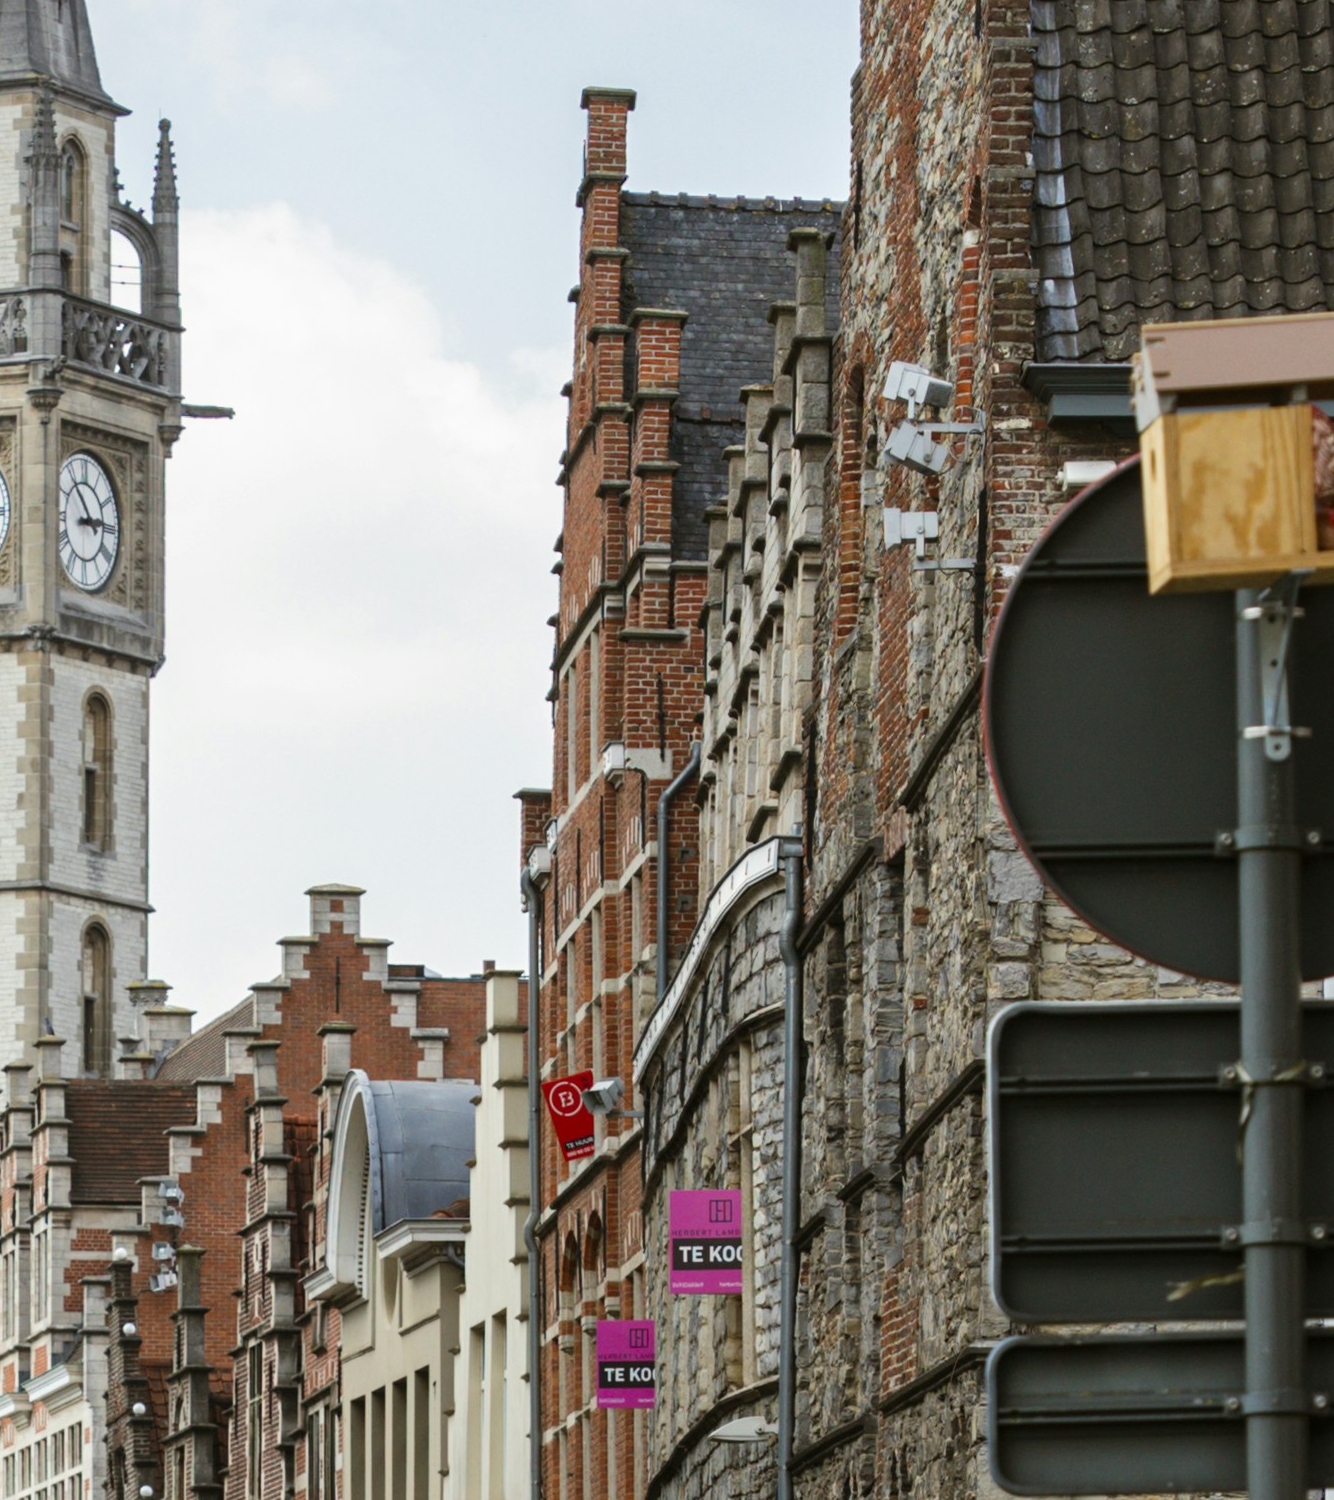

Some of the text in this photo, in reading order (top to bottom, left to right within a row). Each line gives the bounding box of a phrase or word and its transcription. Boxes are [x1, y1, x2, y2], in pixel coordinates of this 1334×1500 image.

[678, 1245, 704, 1263] TE
[604, 1367, 656, 1382] TE KO
